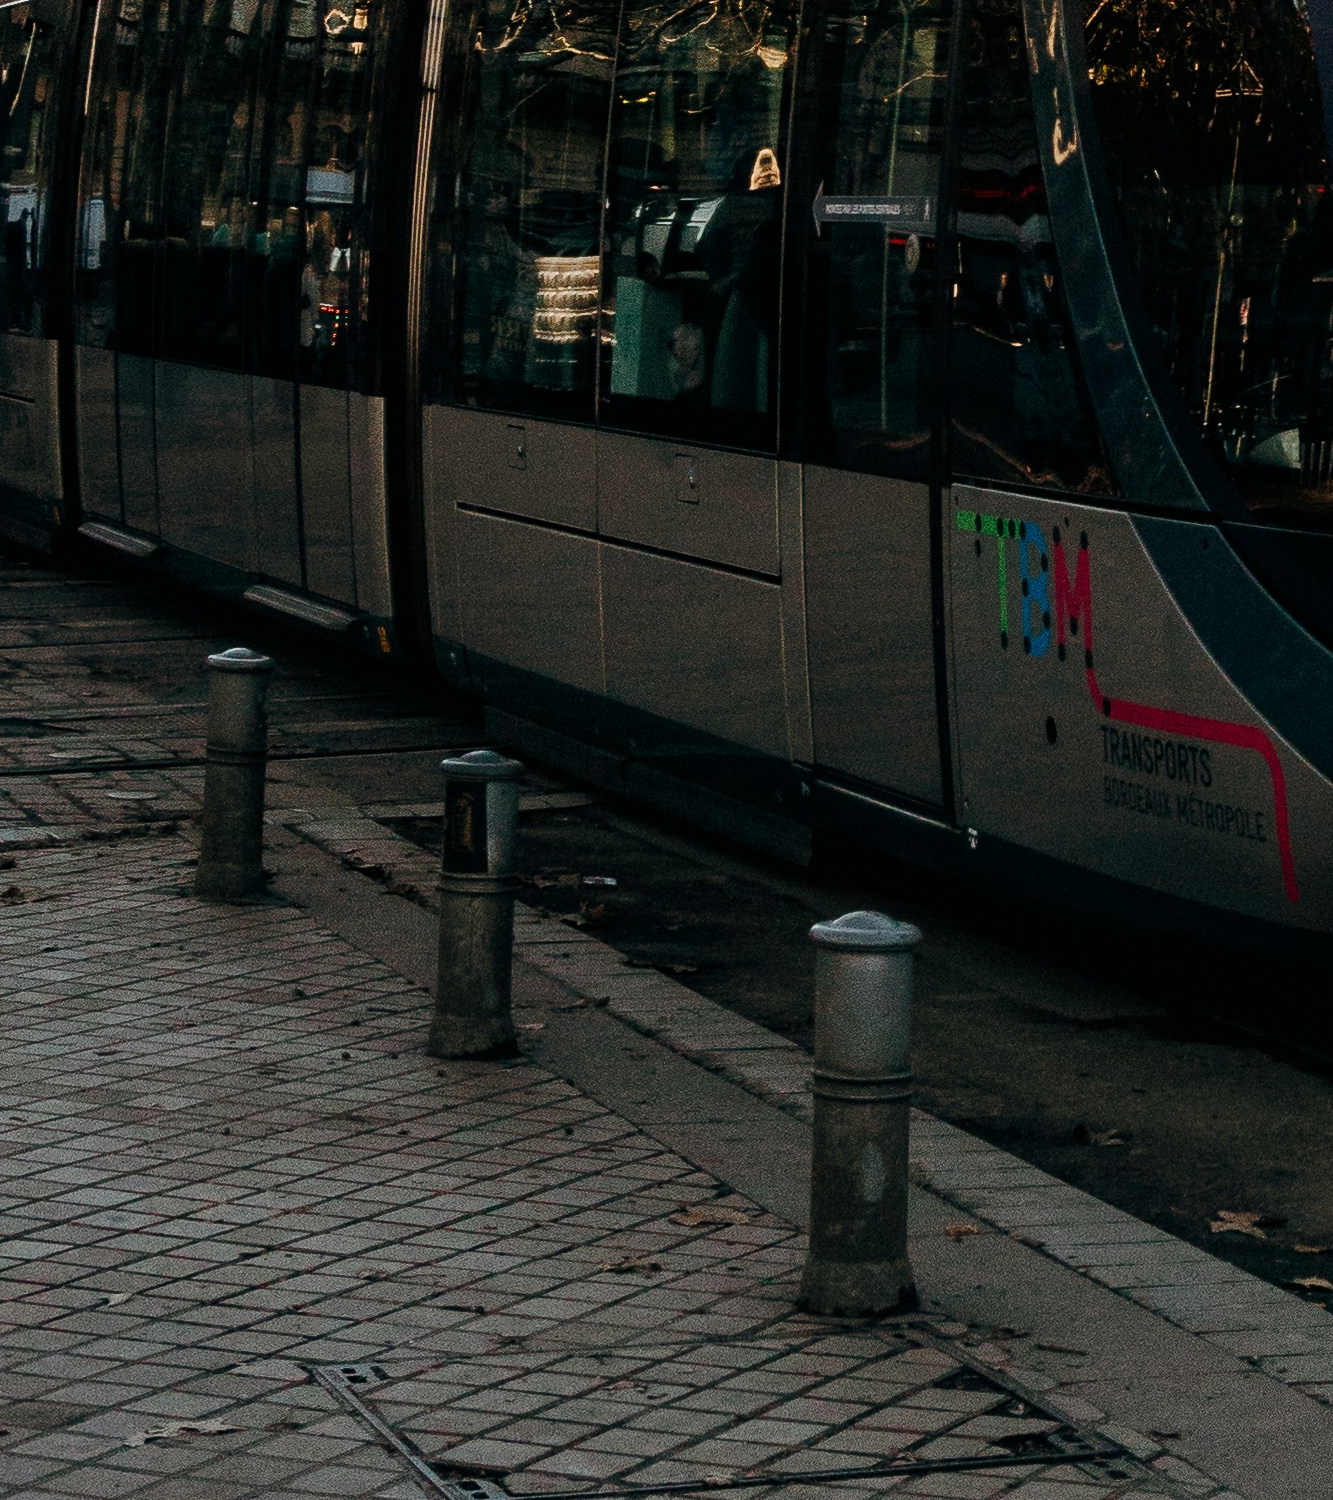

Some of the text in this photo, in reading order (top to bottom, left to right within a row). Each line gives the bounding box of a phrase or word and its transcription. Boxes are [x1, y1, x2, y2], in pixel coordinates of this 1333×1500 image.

[956, 510, 1093, 662] TBM
[1100, 725, 1212, 788] TRANSPORTS
[1104, 776, 1267, 843] BORDEAUX MÉTROPOLE
